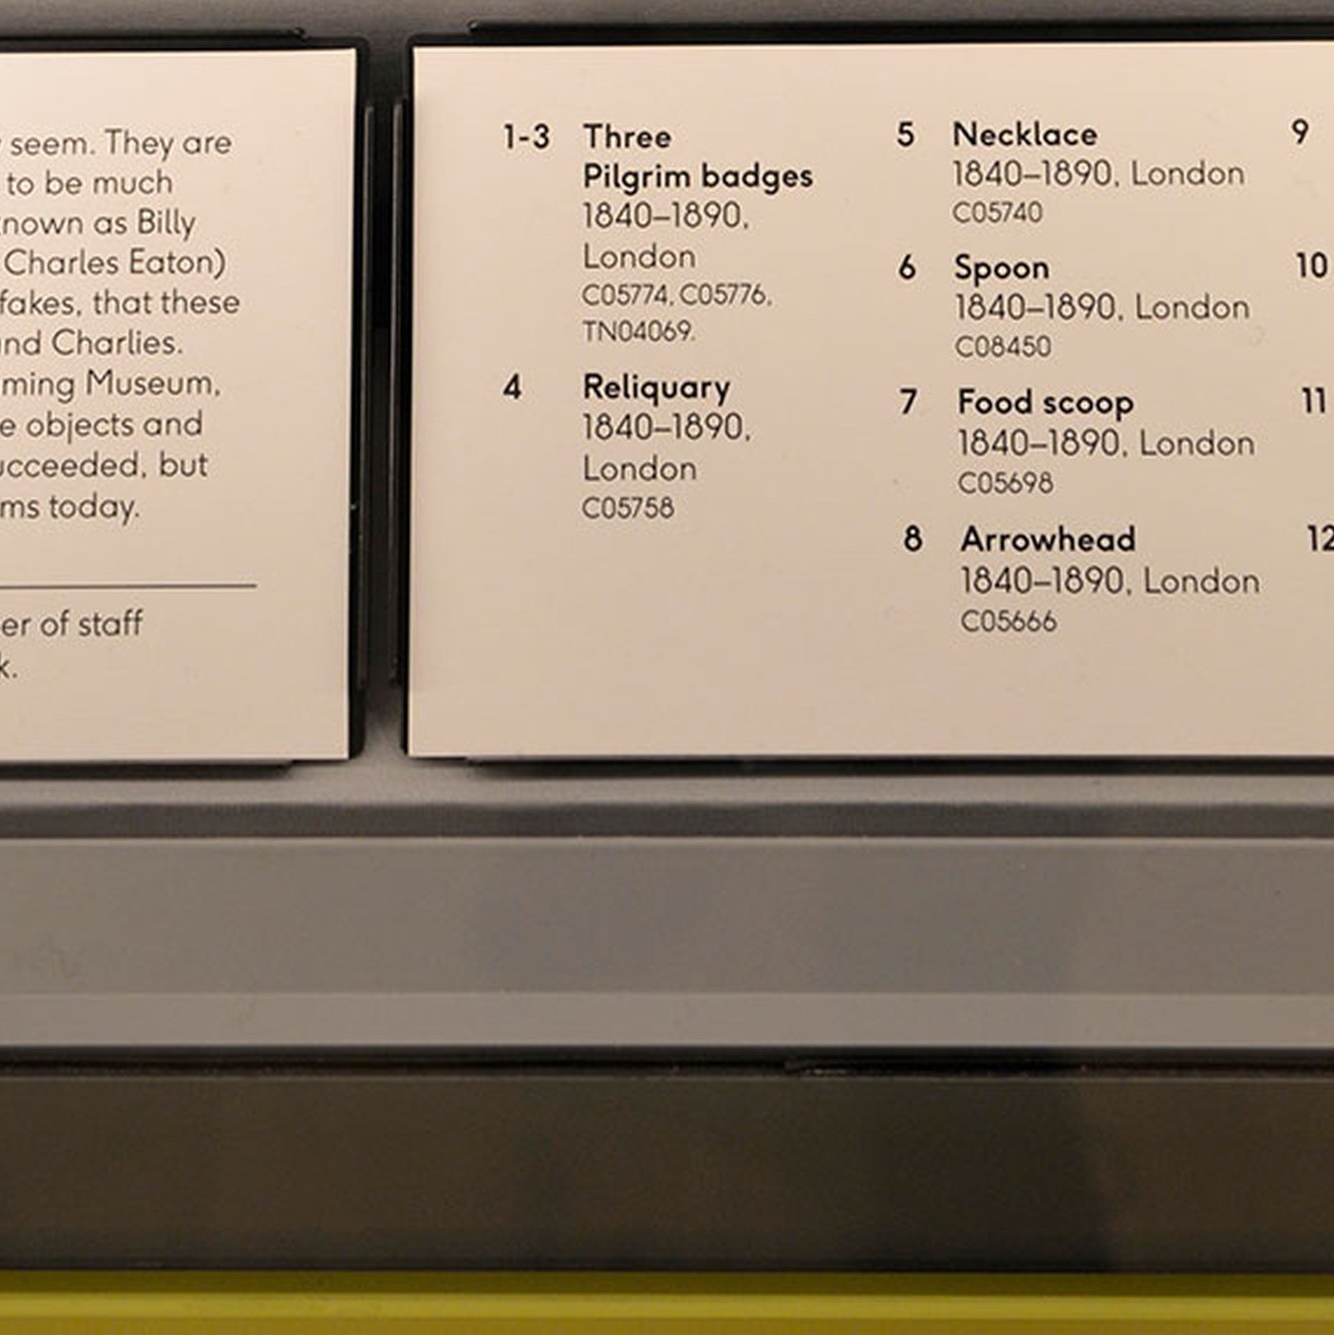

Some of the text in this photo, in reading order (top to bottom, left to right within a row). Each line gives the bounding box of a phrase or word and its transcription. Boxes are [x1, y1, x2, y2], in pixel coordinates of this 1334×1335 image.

[10, 136, 96, 157] seem.
[103, 127, 175, 163] They
[182, 135, 233, 156] are
[504, 122, 672, 150] 1-3 Three
[896, 119, 1098, 148] 5 Necklace
[1291, 117, 1310, 145] 9
[6, 172, 35, 197] to
[45, 168, 84, 197] be
[93, 167, 173, 196] much
[584, 161, 814, 197] Pilgrim badges
[1131, 159, 1245, 187] London
[93, 215, 128, 236] as
[137, 207, 197, 243] Billy
[951, 200, 1044, 225] C05740
[3, 247, 120, 277] Charles
[129, 246, 226, 281] Eaton)
[583, 241, 696, 270] London
[1296, 251, 1329, 279] 10
[898, 252, 1050, 289] 6 Spoon
[92, 287, 154, 316] that
[160, 287, 241, 315] these
[581, 282, 773, 307] C05774, C05776,
[51, 327, 183, 357] Charlies.
[954, 334, 1052, 359] C08450
[86, 368, 221, 397] Museum,
[502, 372, 731, 408] 4 Reliquary
[899, 387, 1135, 423] 7 Food scoop
[1301, 386, 1326, 414] 11
[25, 409, 135, 446] objects
[142, 408, 203, 438] and
[159, 449, 209, 478] but
[583, 453, 697, 482] London
[957, 470, 1055, 495] C05698
[48, 490, 140, 527] today.
[581, 495, 675, 520] C05758
[903, 524, 1136, 553] 8 Arrowhead
[39, 608, 71, 638] of
[78, 607, 144, 638] staff
[960, 608, 1058, 633] C05666
